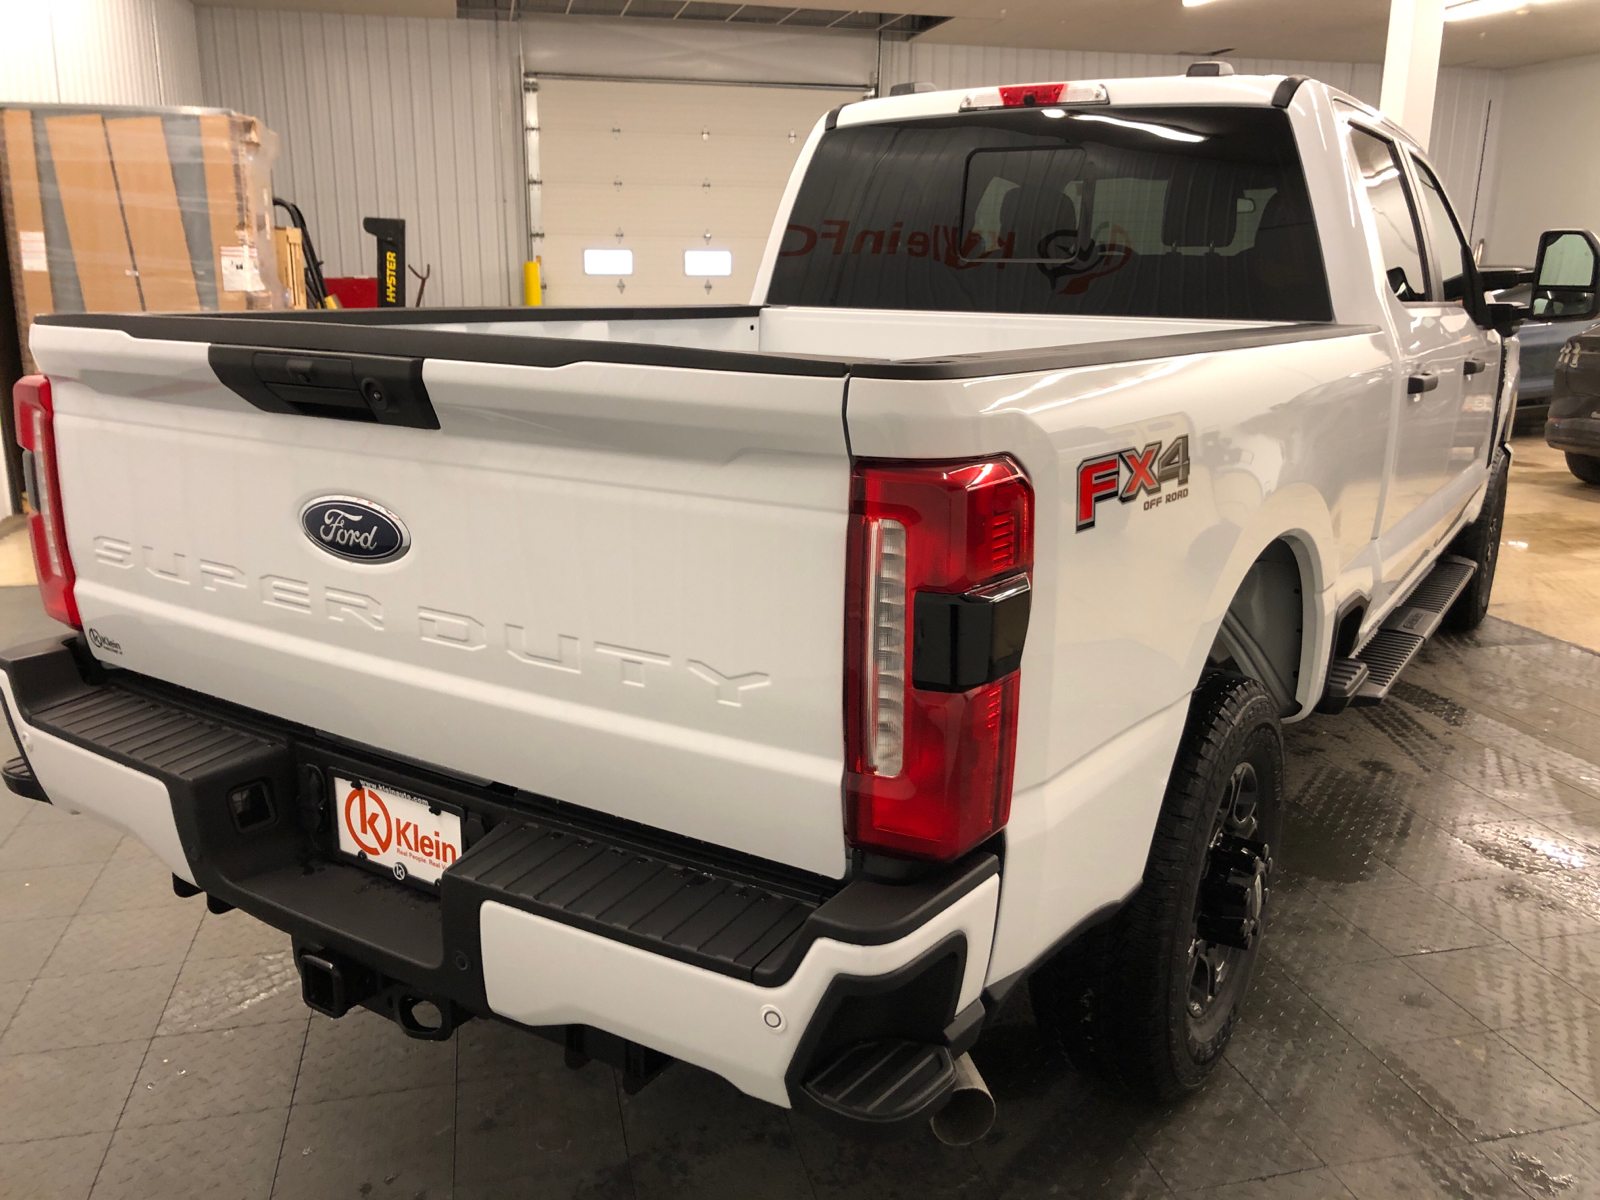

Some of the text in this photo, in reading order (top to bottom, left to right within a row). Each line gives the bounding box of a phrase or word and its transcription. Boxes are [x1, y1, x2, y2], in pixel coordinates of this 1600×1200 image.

[386, 251, 396, 303] HYSTER
[1076, 433, 1190, 534] FX4
[1143, 488, 1189, 511] OFF ROAD
[320, 508, 378, 551] Ford
[93, 536, 771, 707] SUPER DUTY
[101, 636, 121, 650] Klein
[396, 818, 457, 863] Klein
[397, 848, 407, 857] Real
[429, 859, 440, 869] Real
